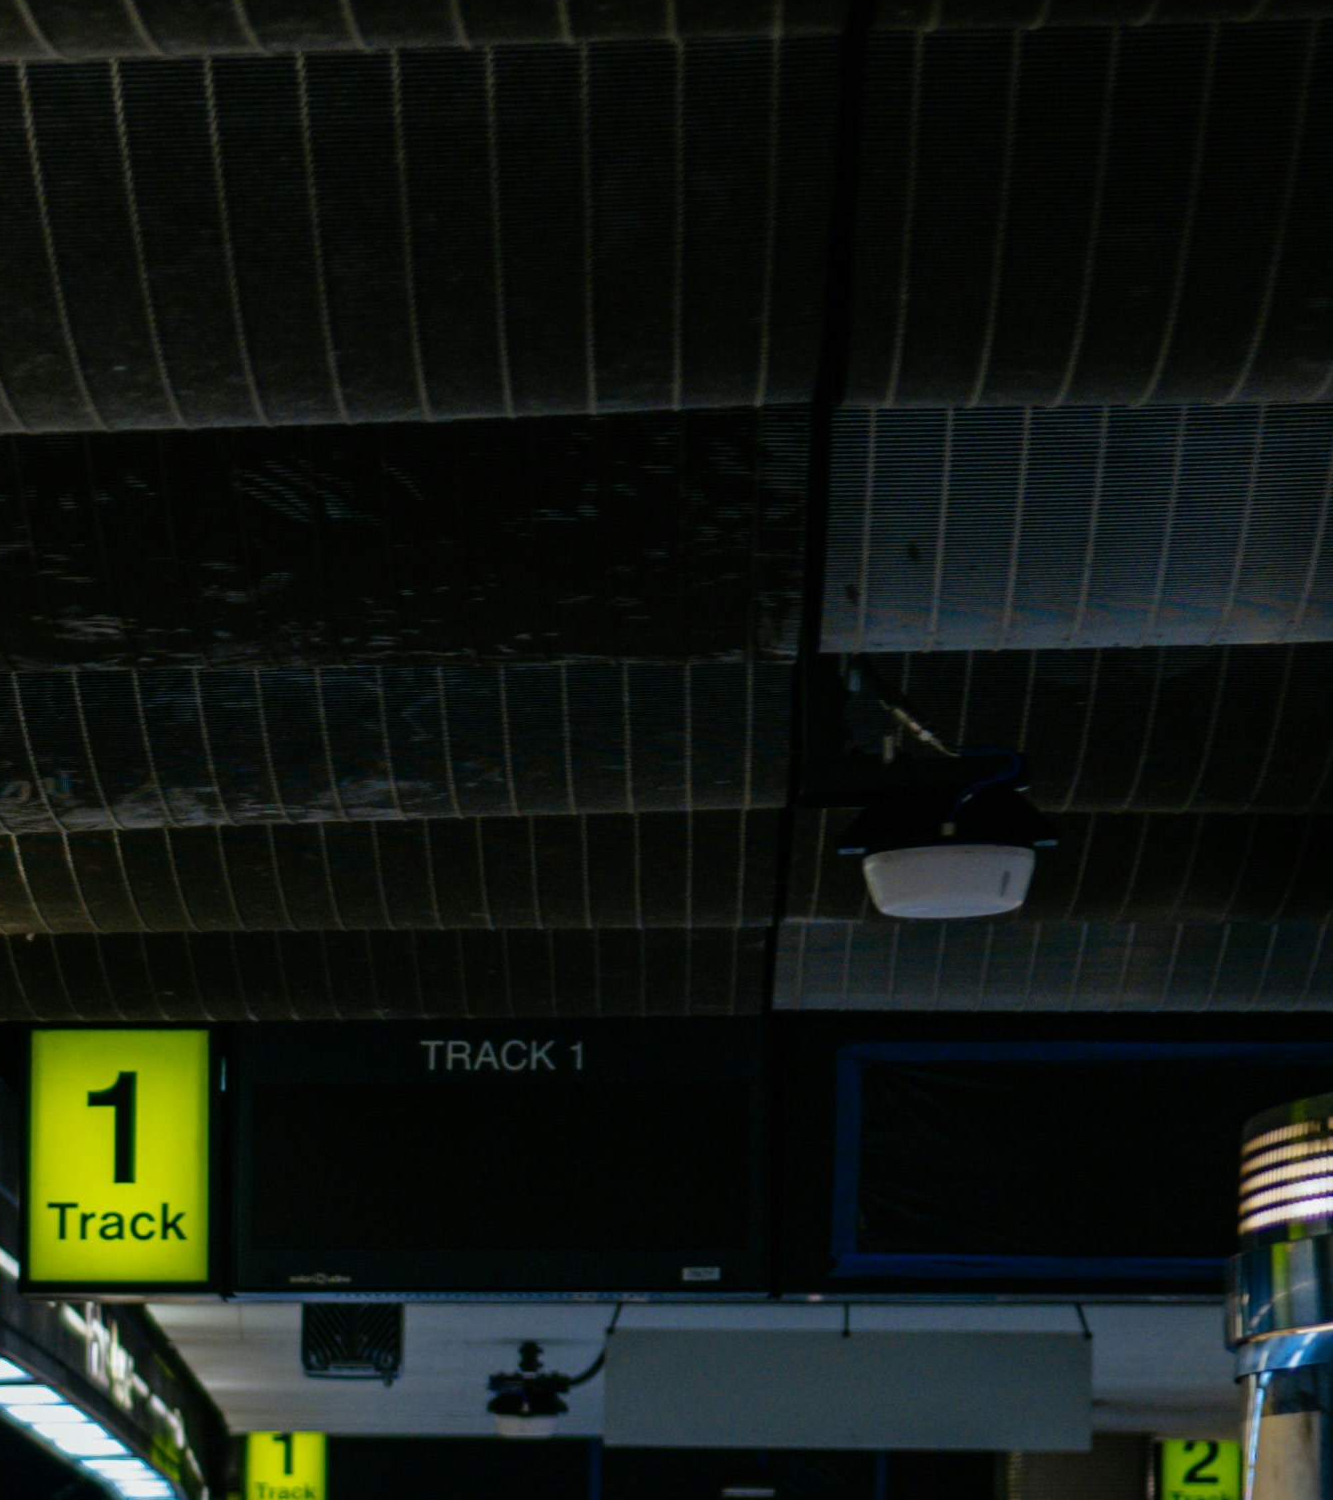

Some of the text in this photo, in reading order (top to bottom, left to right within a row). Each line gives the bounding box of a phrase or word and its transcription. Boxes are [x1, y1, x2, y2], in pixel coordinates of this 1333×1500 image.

[418, 1039, 587, 1073] TRACK 1
[86, 1071, 137, 1185] 1
[48, 1201, 188, 1242] Track
[272, 1433, 292, 1475] 1
[1183, 1441, 1220, 1484] 2
[256, 1482, 316, 1500] Track
